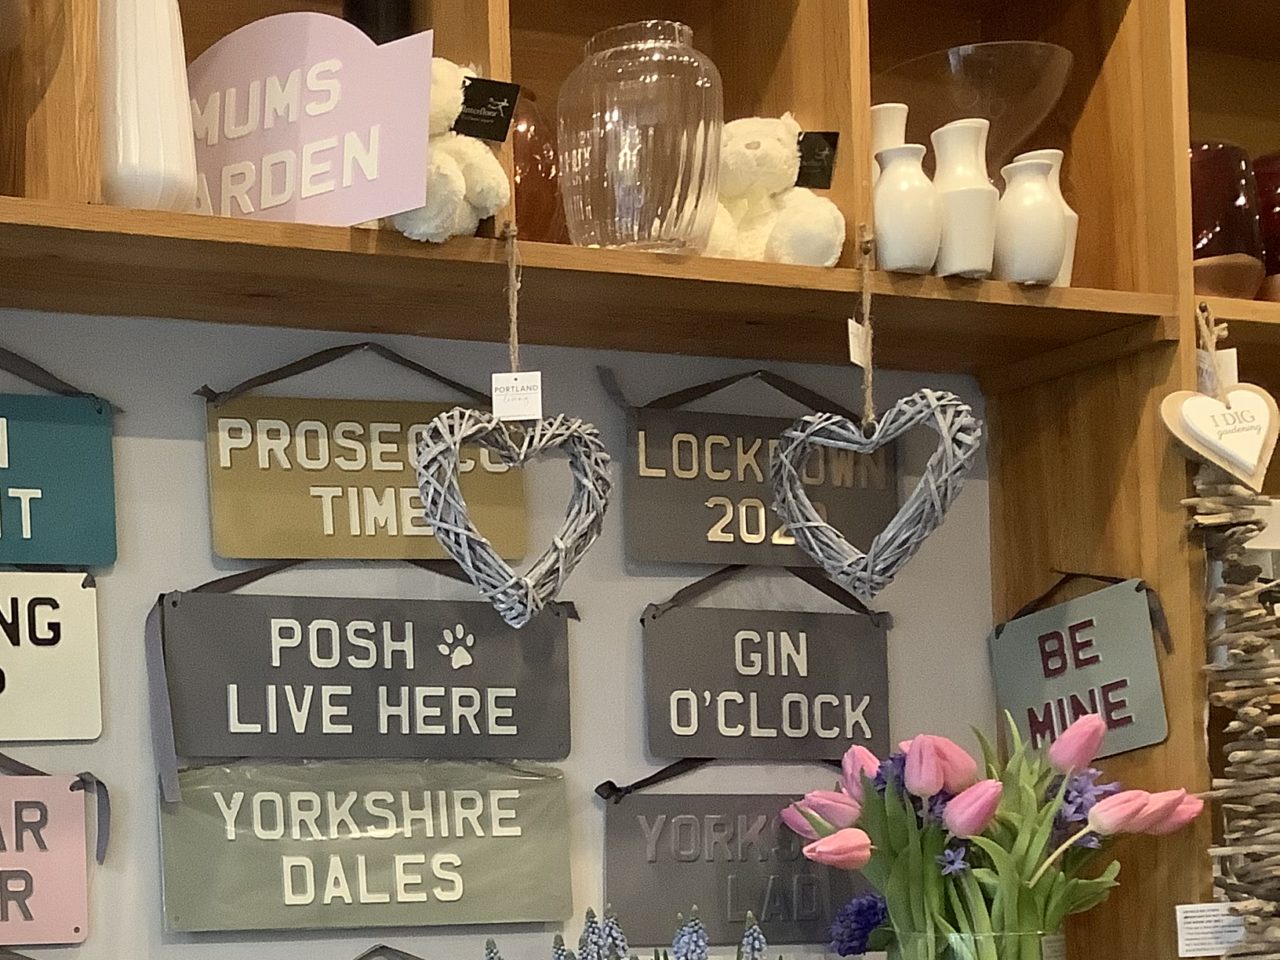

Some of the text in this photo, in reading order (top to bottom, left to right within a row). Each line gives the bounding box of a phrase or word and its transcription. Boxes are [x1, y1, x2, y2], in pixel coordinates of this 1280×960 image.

[192, 59, 343, 146] MUMS
[1211, 410, 1255, 427] I DIG
[638, 431, 888, 489] LOCKOWN
[310, 486, 434, 536] TIME
[270, 618, 414, 669] POSH
[734, 631, 808, 676] GIN
[1038, 619, 1100, 678] BE
[227, 684, 518, 734] LIVE HERE
[670, 688, 872, 739] O'CLOCK
[213, 789, 521, 840] YORKSHIRE
[281, 853, 463, 905] DALES
